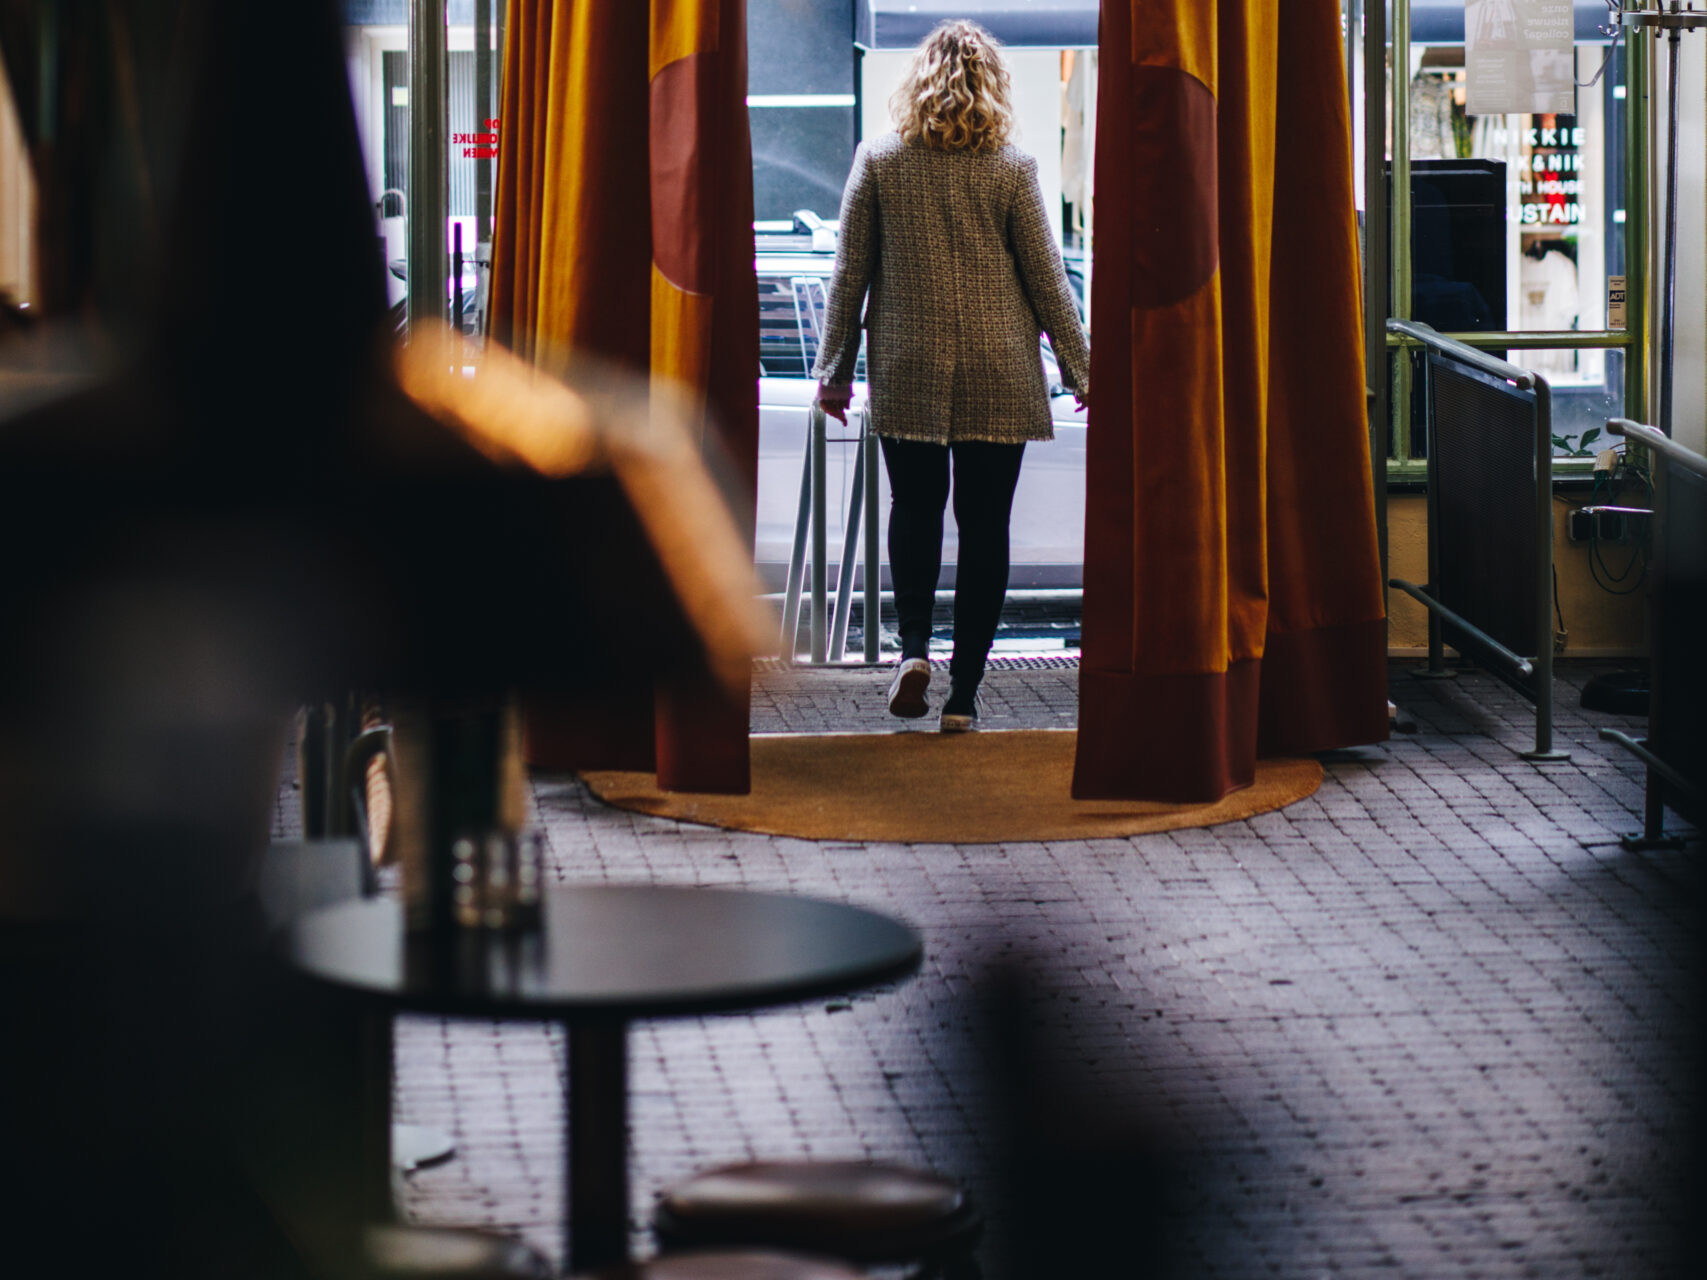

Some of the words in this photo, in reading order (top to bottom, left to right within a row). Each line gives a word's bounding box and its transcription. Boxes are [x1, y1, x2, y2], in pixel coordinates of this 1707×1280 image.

[1493, 128, 1586, 146] NIKKIE
[1536, 180, 1584, 195] HOUSE
[1610, 292, 1624, 300] ADT
